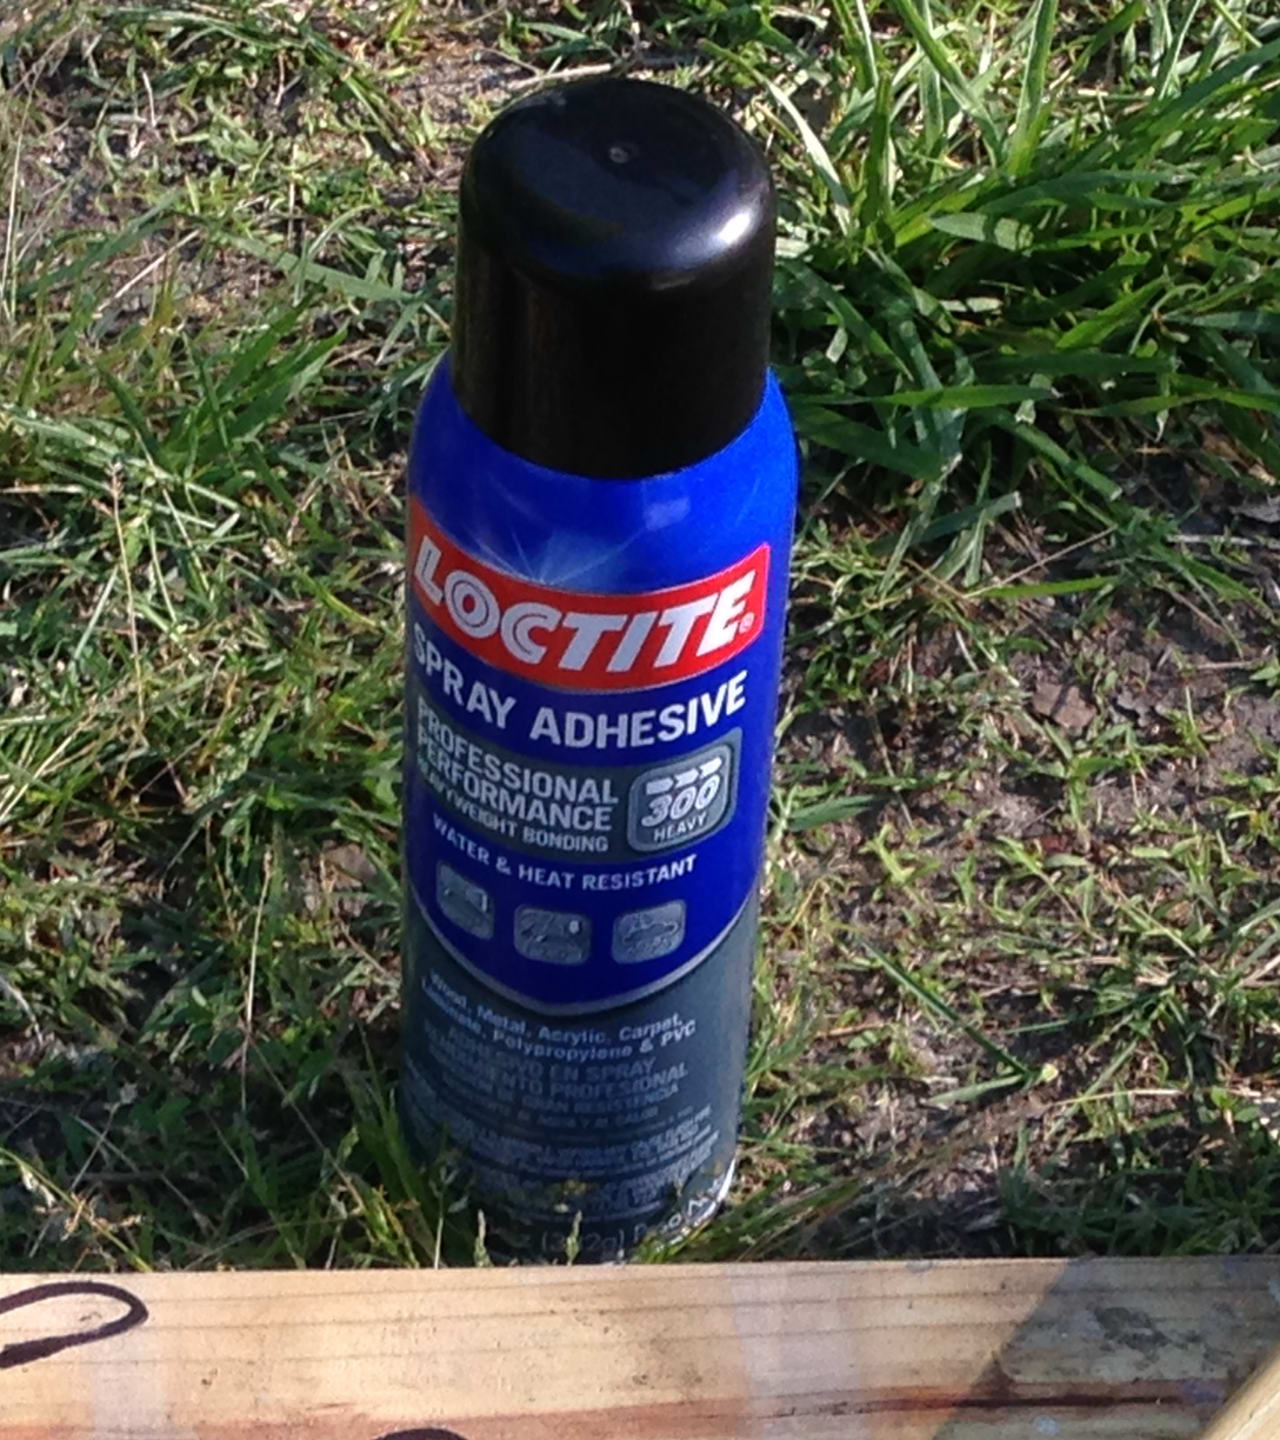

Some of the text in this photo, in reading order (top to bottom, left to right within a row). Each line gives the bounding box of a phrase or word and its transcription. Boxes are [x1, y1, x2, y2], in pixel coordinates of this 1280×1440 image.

[414, 535, 757, 673] LOCTITE
[413, 622, 748, 750] SPRAY ADHESIVE
[418, 695, 619, 805] PROFESSIONAL
[418, 722, 614, 832] PERFORMANCE
[642, 773, 722, 828] 300
[653, 813, 709, 843] HEAVY
[433, 811, 699, 892] WATER & HEAT RESISTANT
[522, 825, 609, 854] BONDING
[585, 1055, 657, 1082] SPRAY
[639, 1037, 655, 1054] &
[660, 1018, 697, 1047] PVC
